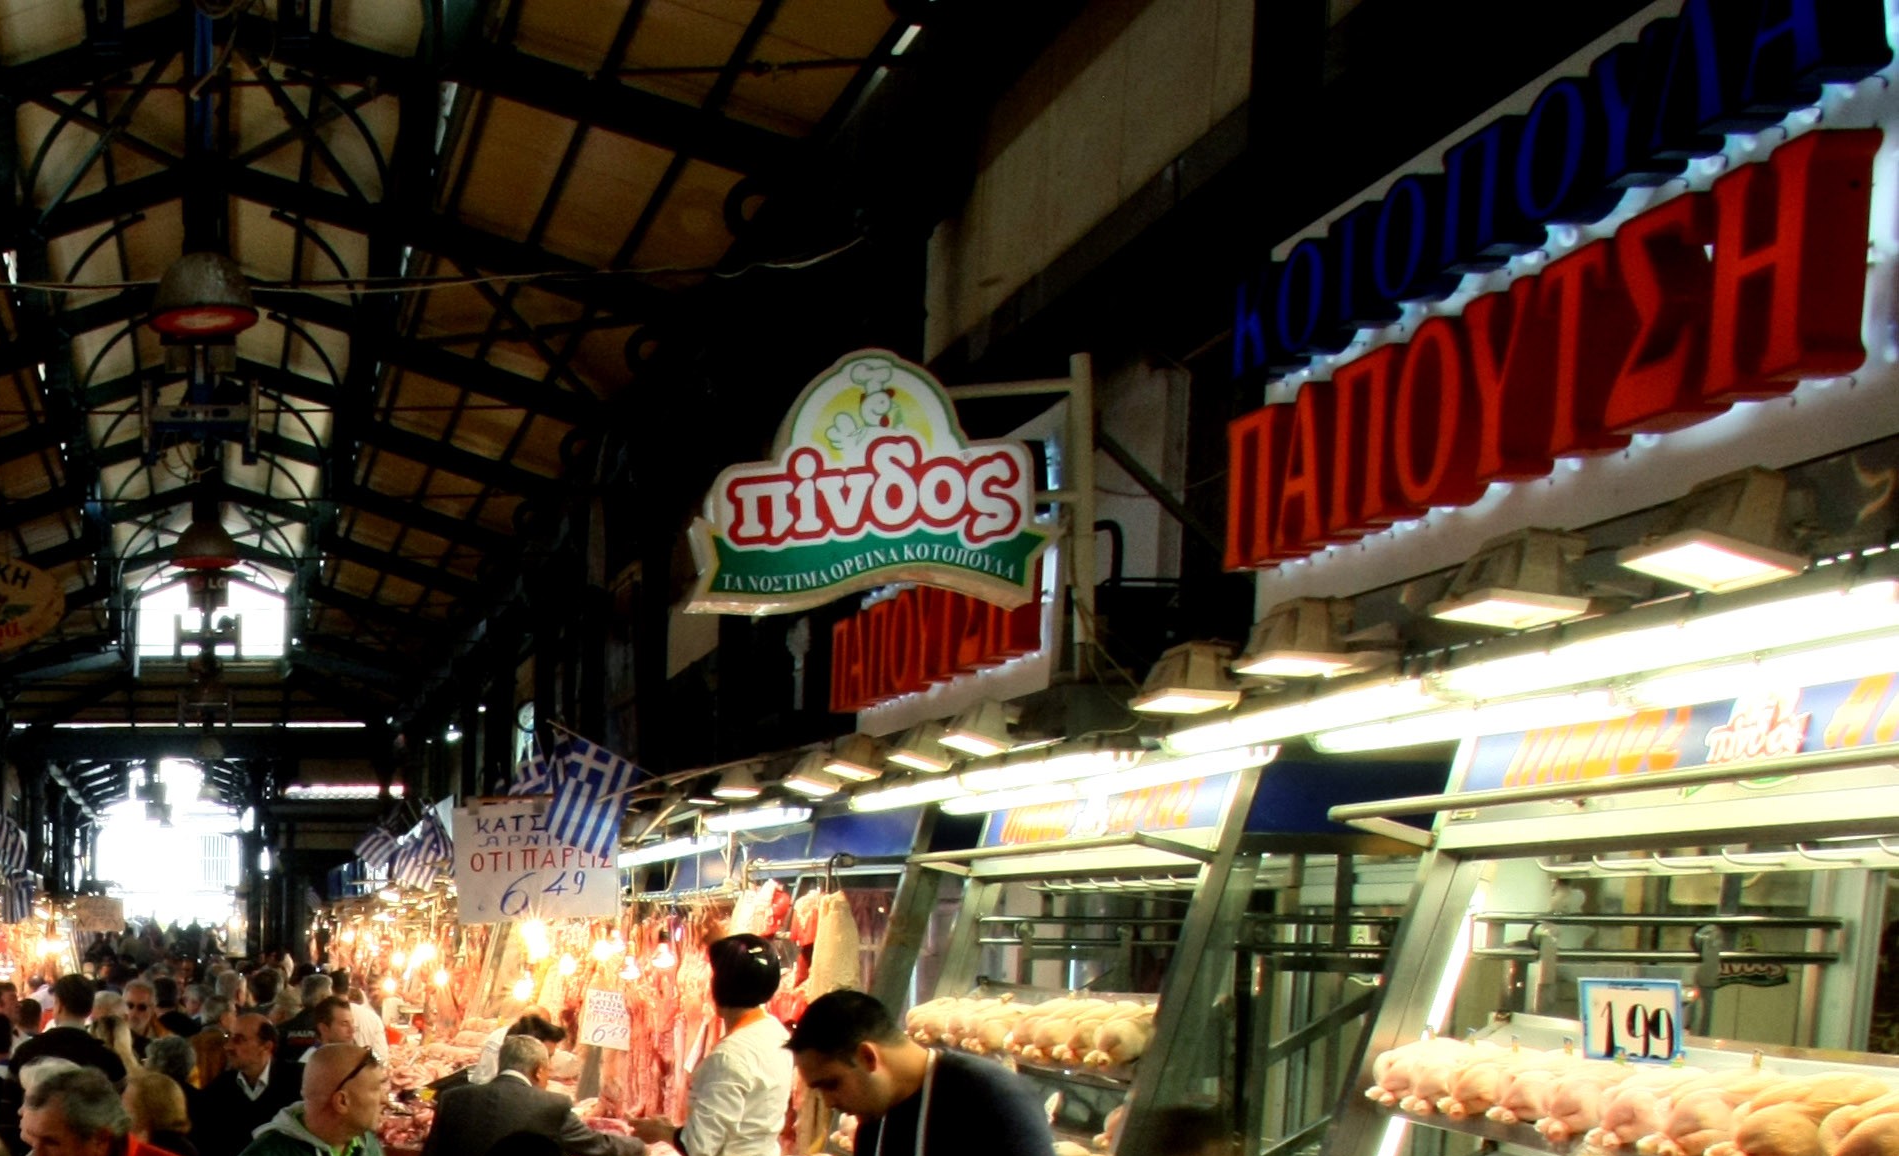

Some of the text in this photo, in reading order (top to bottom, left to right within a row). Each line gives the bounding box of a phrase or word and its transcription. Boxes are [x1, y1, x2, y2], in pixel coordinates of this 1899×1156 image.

[1224, 130, 1826, 572] ΠΑΠΟΥΤΣΗ
[729, 438, 1018, 543] πίνδος
[721, 544, 1016, 592] ΤΑ ΝΟΣΤΙΜΑ ΟΡΕΙΝΑ ΚΟΤΟΠΟΥΛΑ
[470, 852, 512, 873] ΟΤΙ
